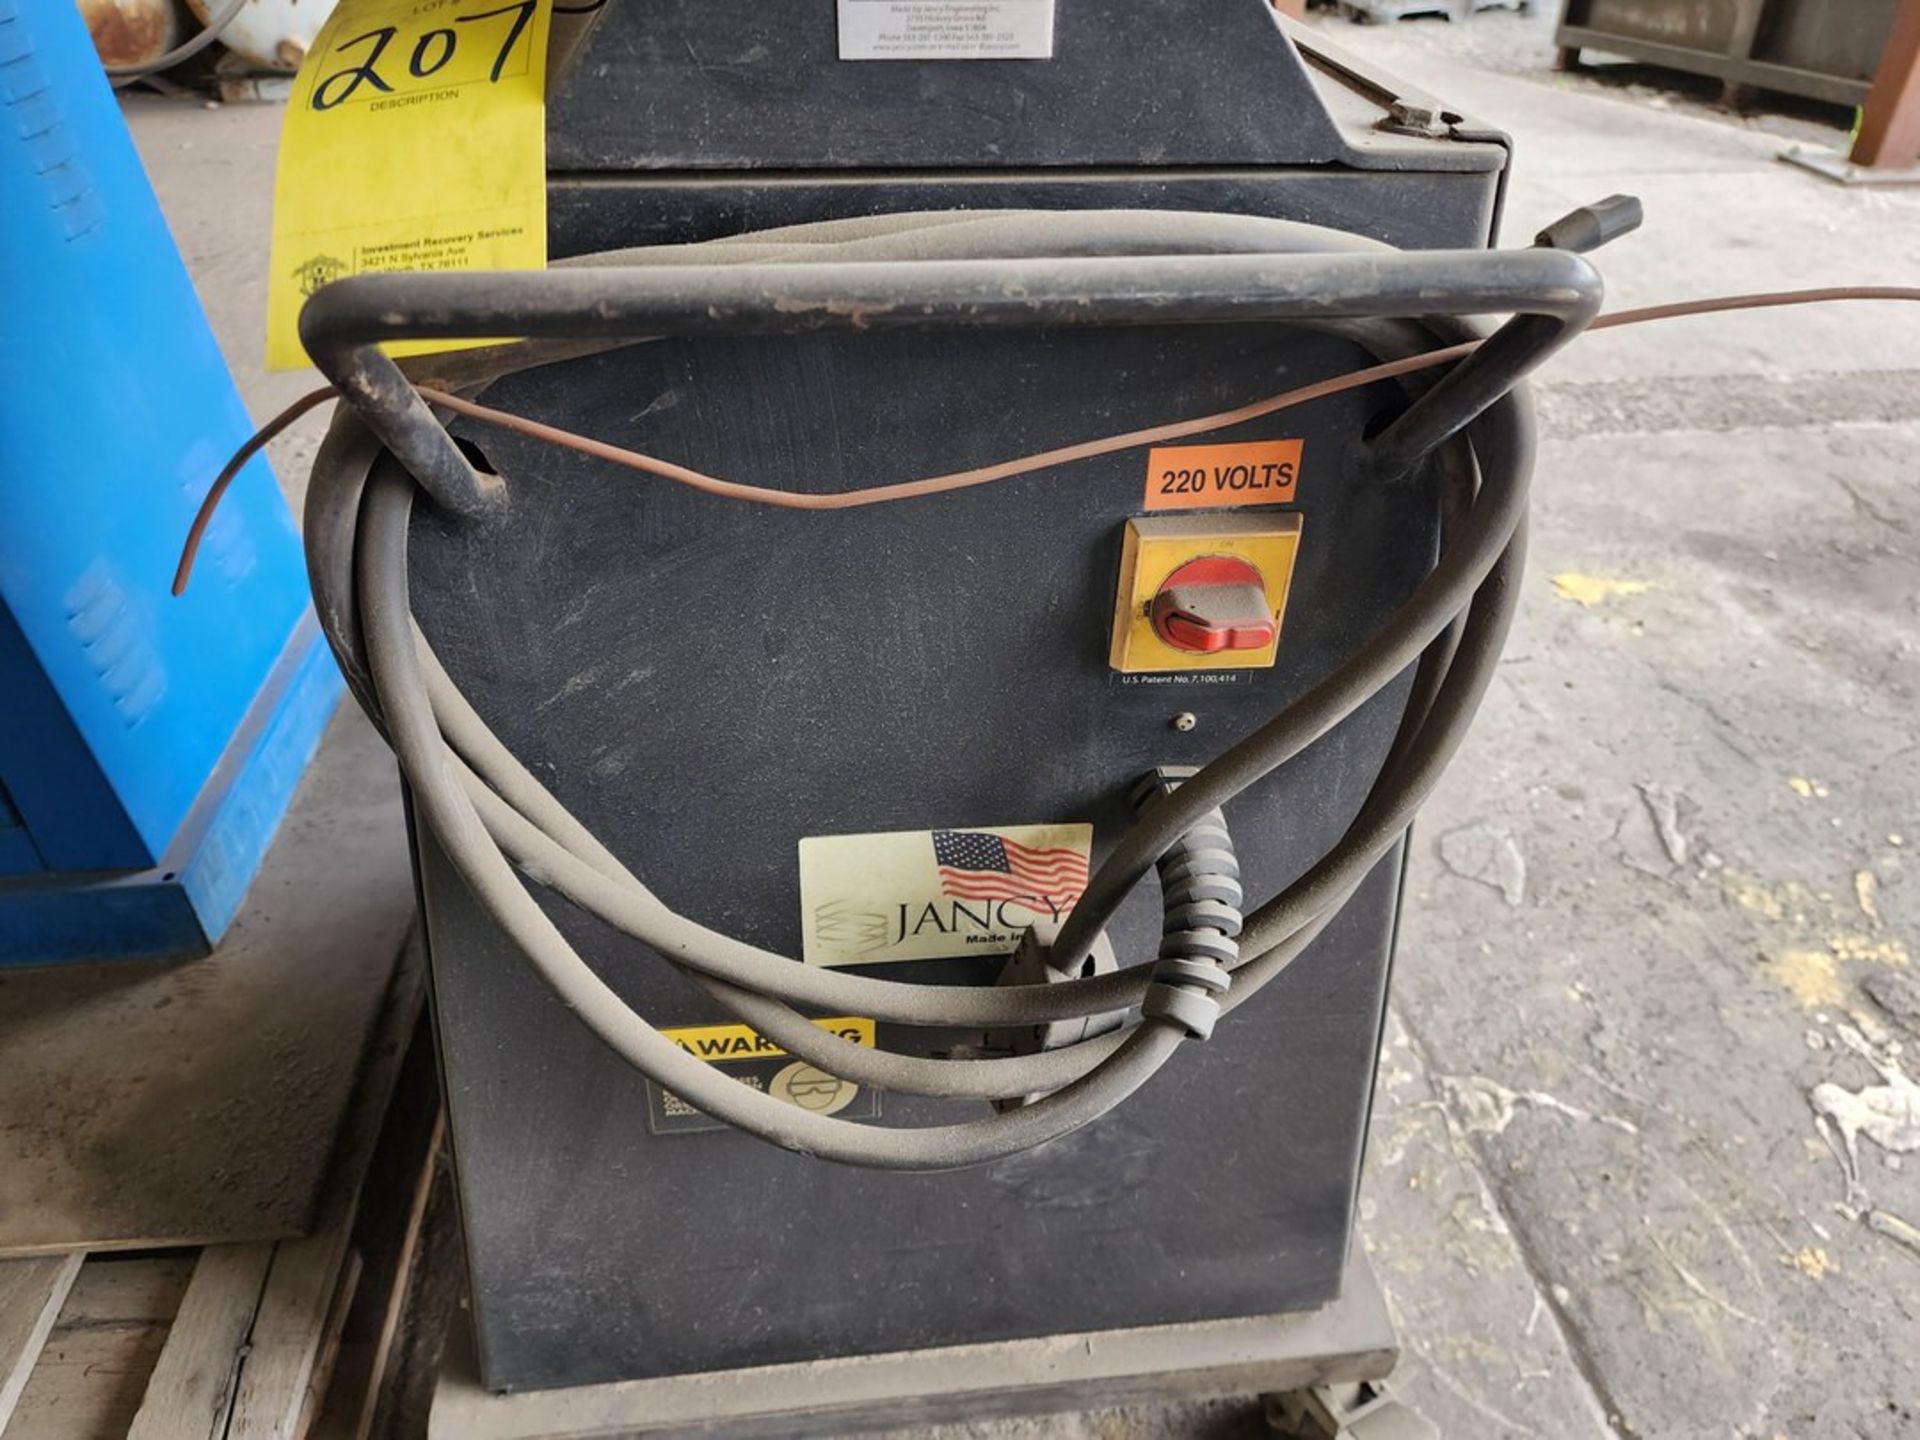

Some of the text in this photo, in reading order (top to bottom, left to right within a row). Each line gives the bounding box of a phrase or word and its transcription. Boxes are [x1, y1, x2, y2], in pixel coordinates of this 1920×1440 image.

[312, 0, 537, 111] 207
[370, 89, 460, 112] DESCRIPTION
[361, 227, 523, 256] Investment Recovery Services
[390, 254, 398, 263] N
[1161, 462, 1294, 495] 220 VOLTS
[1140, 675, 1172, 684] Patent
[1173, 675, 1189, 684] No.
[892, 895, 1075, 946] JANCY
[966, 933, 1006, 944] Made
